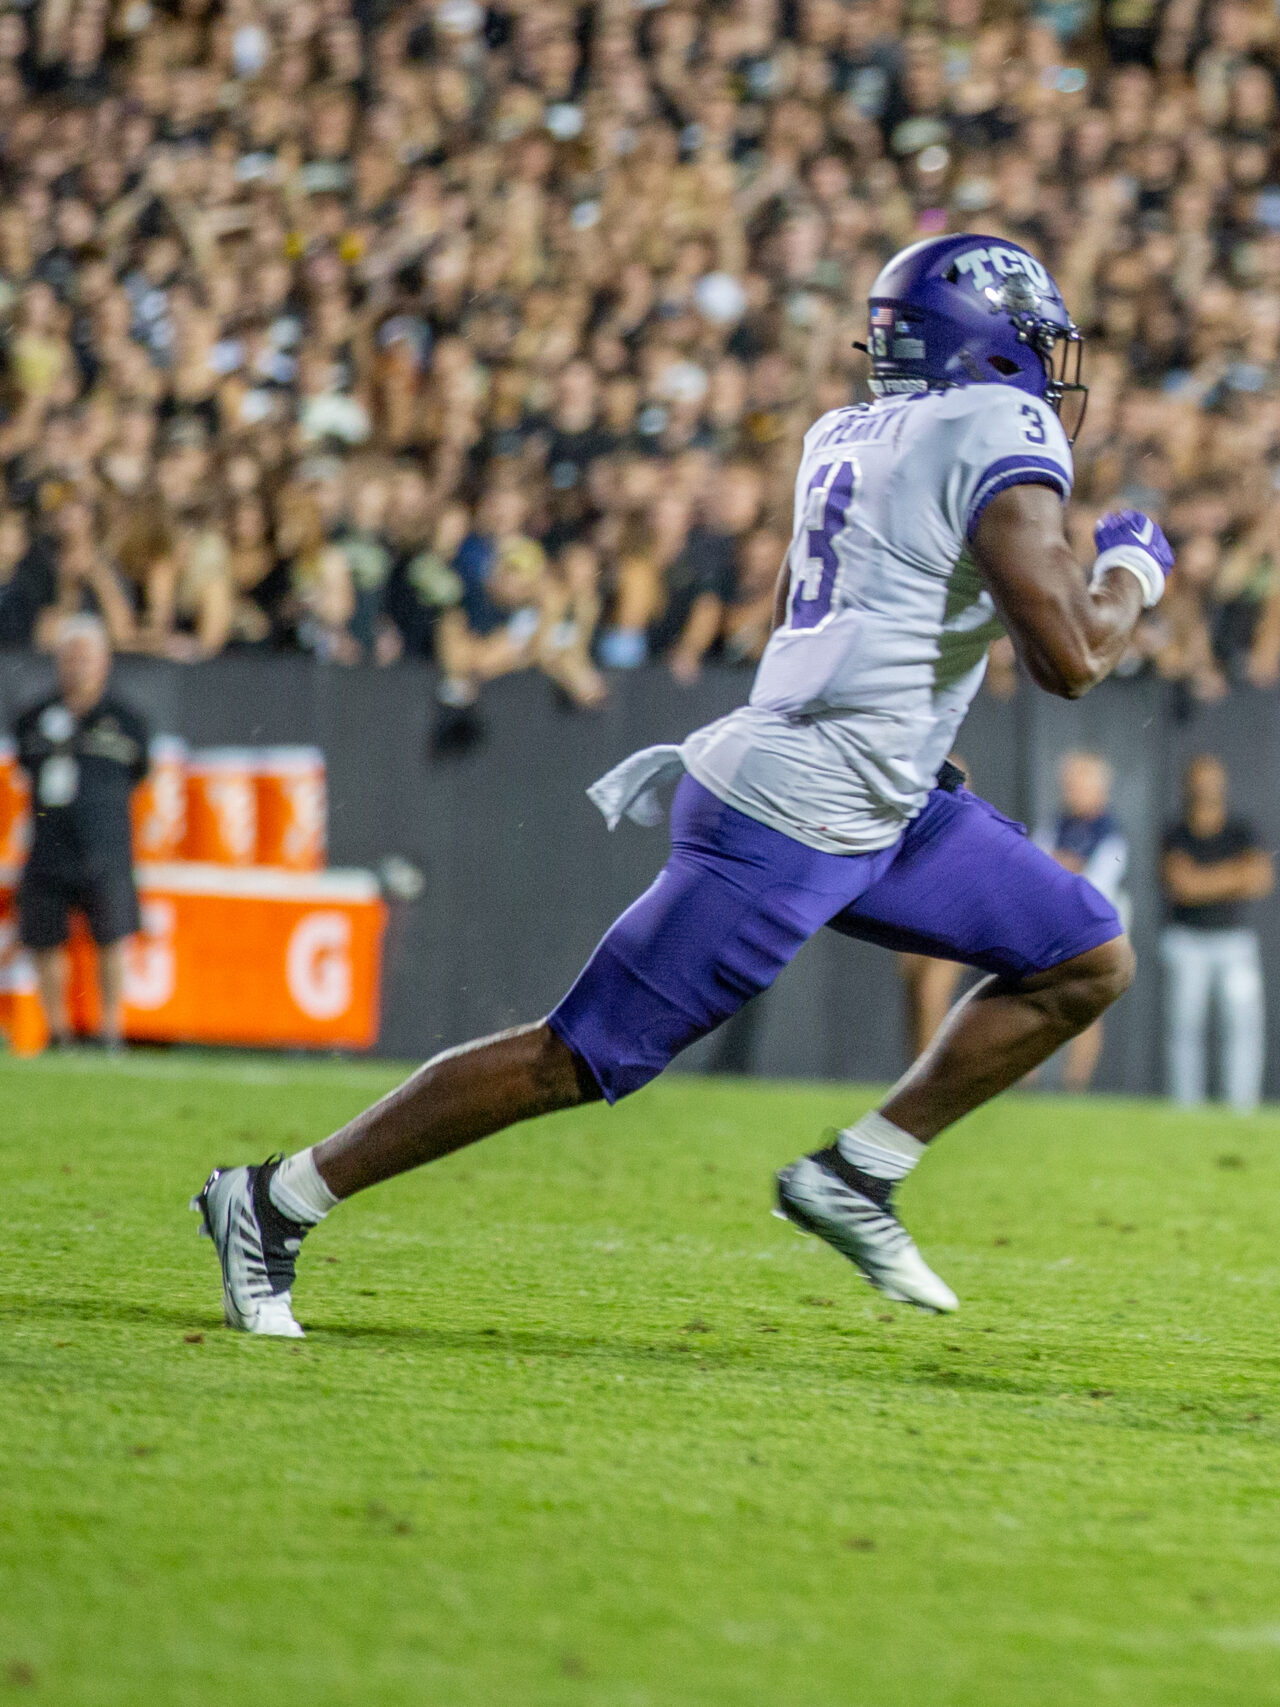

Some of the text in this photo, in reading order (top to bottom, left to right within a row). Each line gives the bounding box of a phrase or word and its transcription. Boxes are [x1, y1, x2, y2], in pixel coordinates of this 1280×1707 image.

[954, 246, 1050, 292] TCU
[1020, 404, 1046, 445] 3
[787, 456, 862, 634] 3
[286, 911, 353, 1022] G
